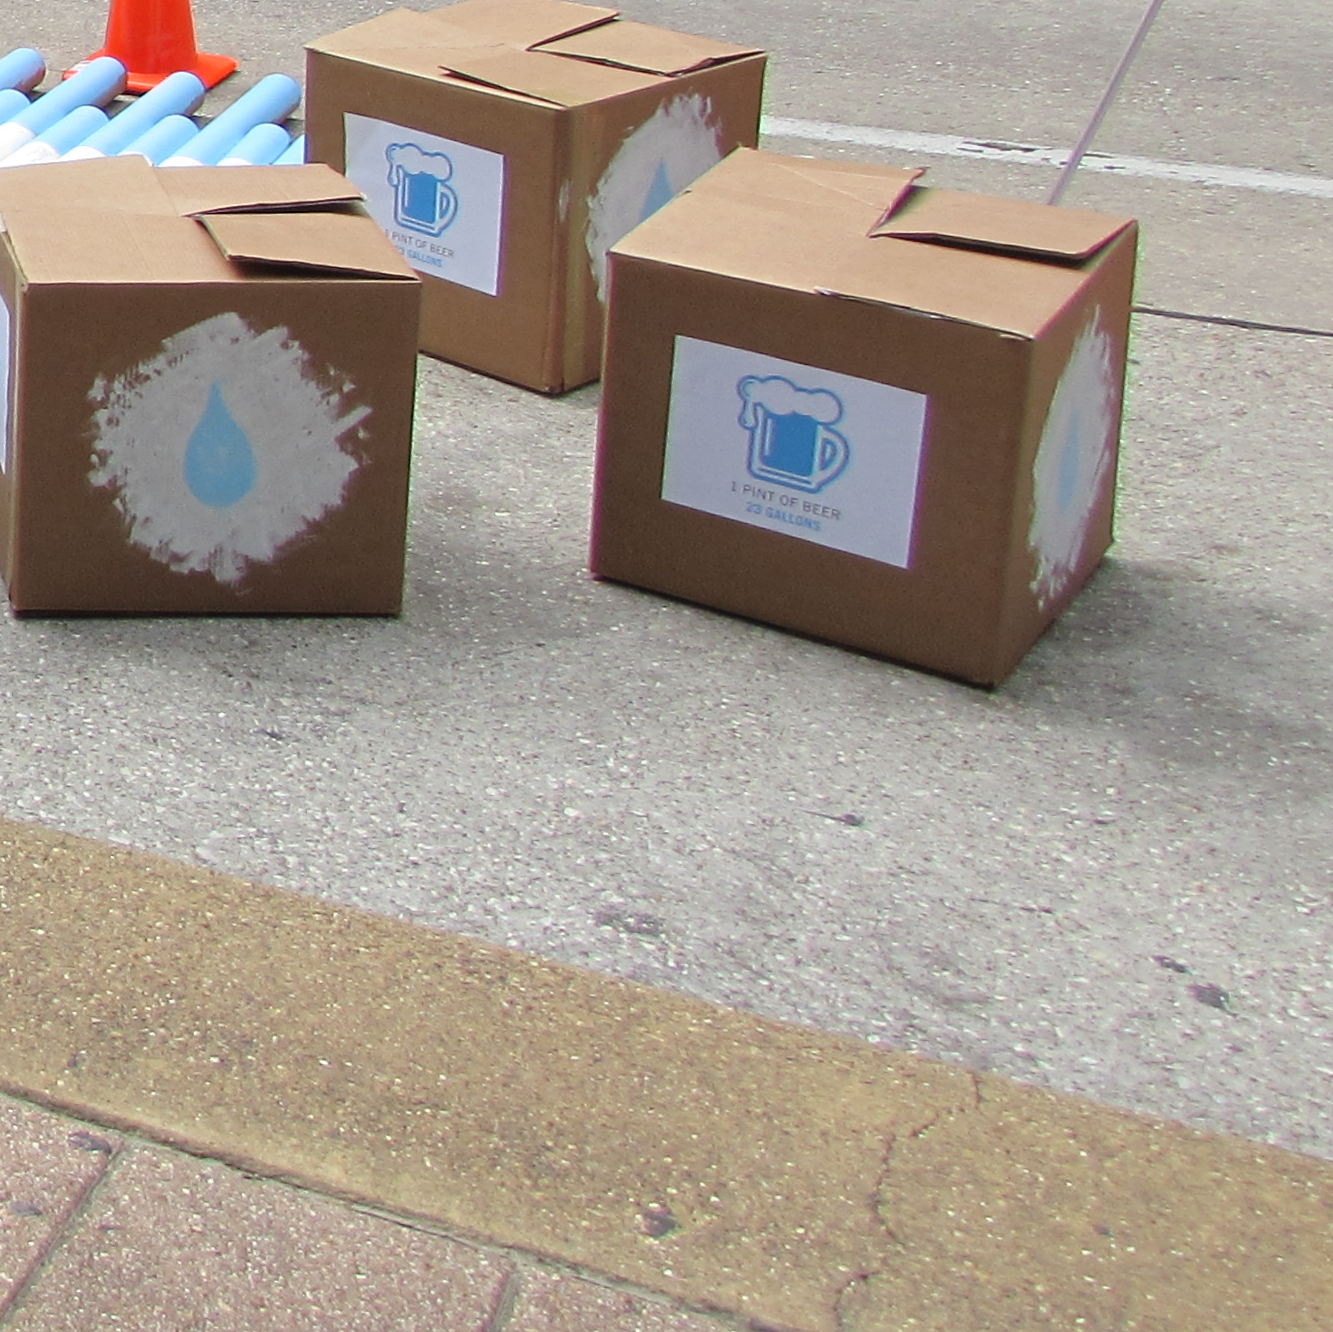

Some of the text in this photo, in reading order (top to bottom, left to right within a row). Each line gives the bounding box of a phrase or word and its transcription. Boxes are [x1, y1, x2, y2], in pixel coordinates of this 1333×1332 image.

[392, 231, 413, 245] PINT
[415, 239, 428, 249] OF
[429, 243, 454, 258] BEER
[731, 481, 842, 521] 1 PINT OF BEER
[745, 501, 821, 531] 23 GALLONS
